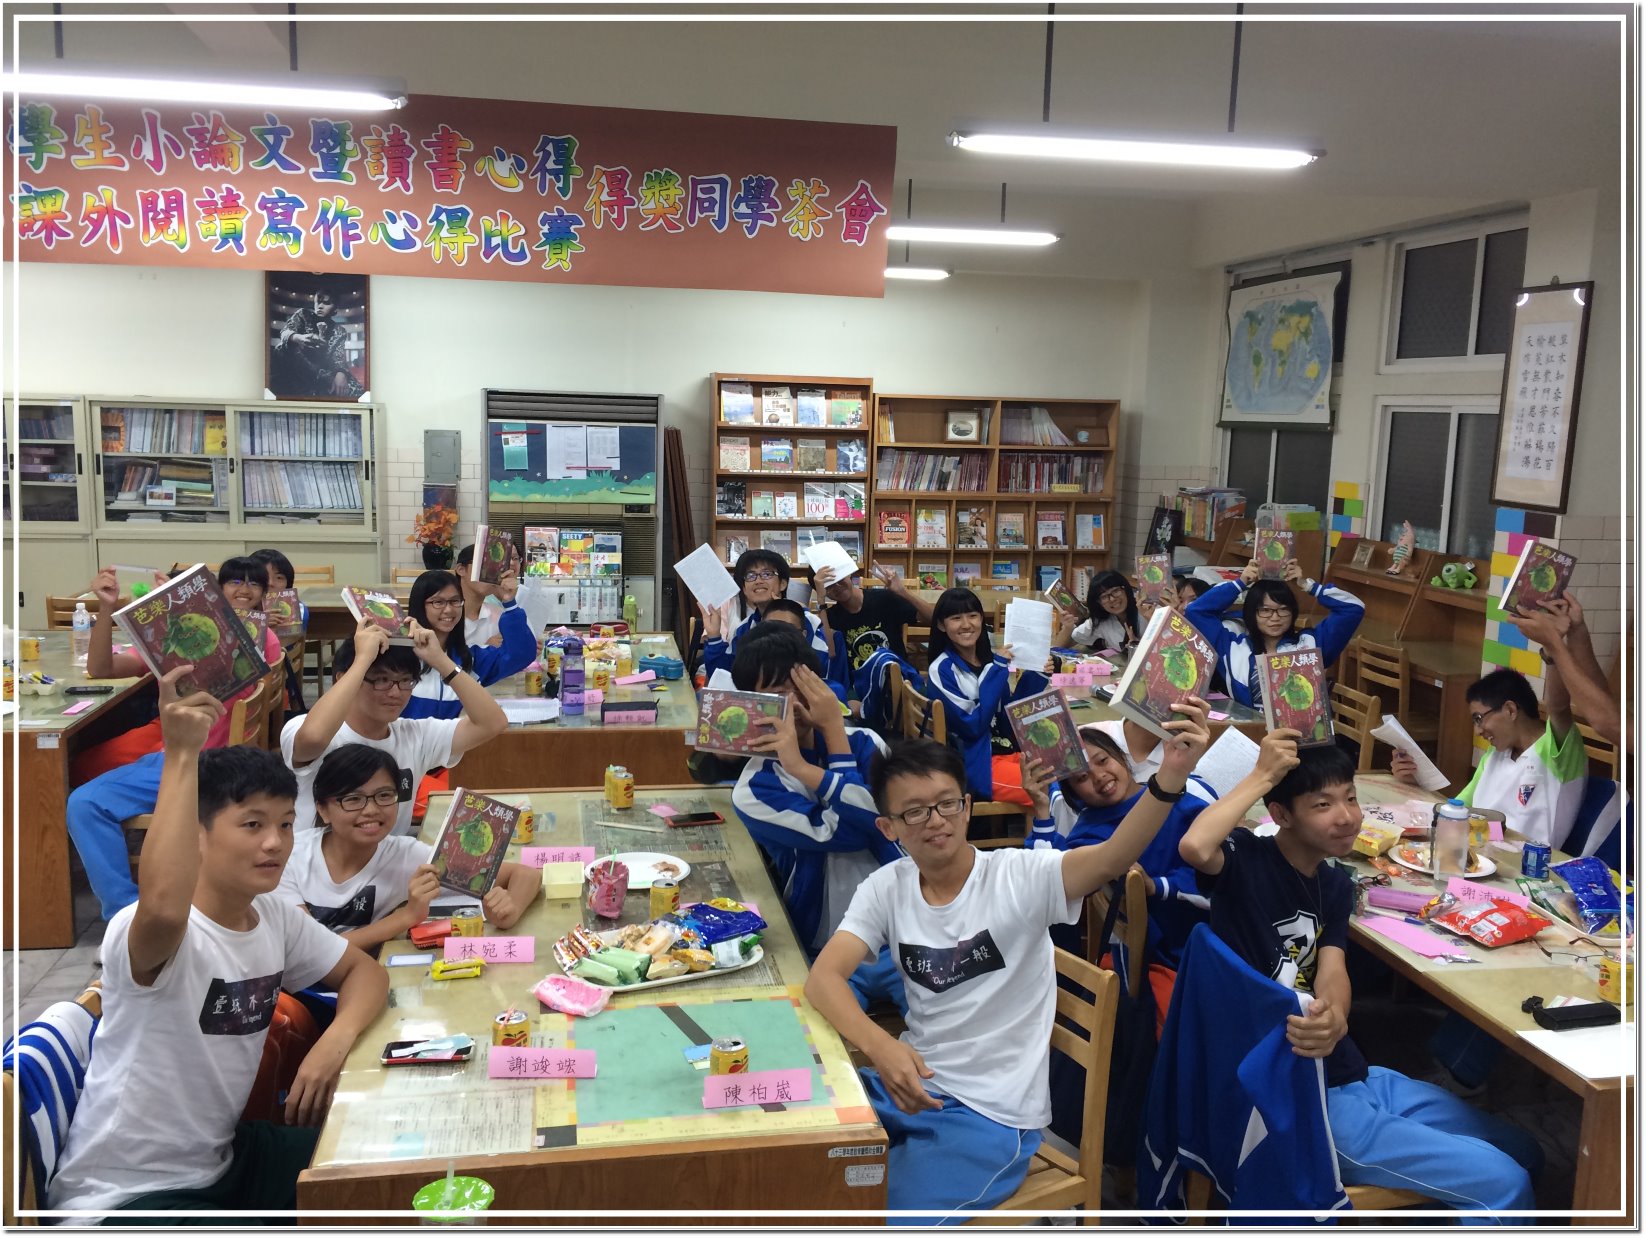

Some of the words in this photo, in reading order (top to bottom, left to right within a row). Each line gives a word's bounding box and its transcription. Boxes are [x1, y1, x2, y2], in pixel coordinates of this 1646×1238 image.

[9, 102, 583, 200] 學生小論文暨讀書心得
[13, 182, 585, 272] 課外閱讀寫作心得比賽
[584, 164, 888, 247] 得獎同學茶會
[132, 574, 208, 625] 芭樂人類學
[1169, 615, 1214, 664] 芭樂人類學
[1270, 652, 1318, 670] 芭樂人類學
[464, 794, 514, 822] 芭樂人類學
[1461, 886, 1510, 902] 謝沛
[459, 940, 518, 959] 林宛柔
